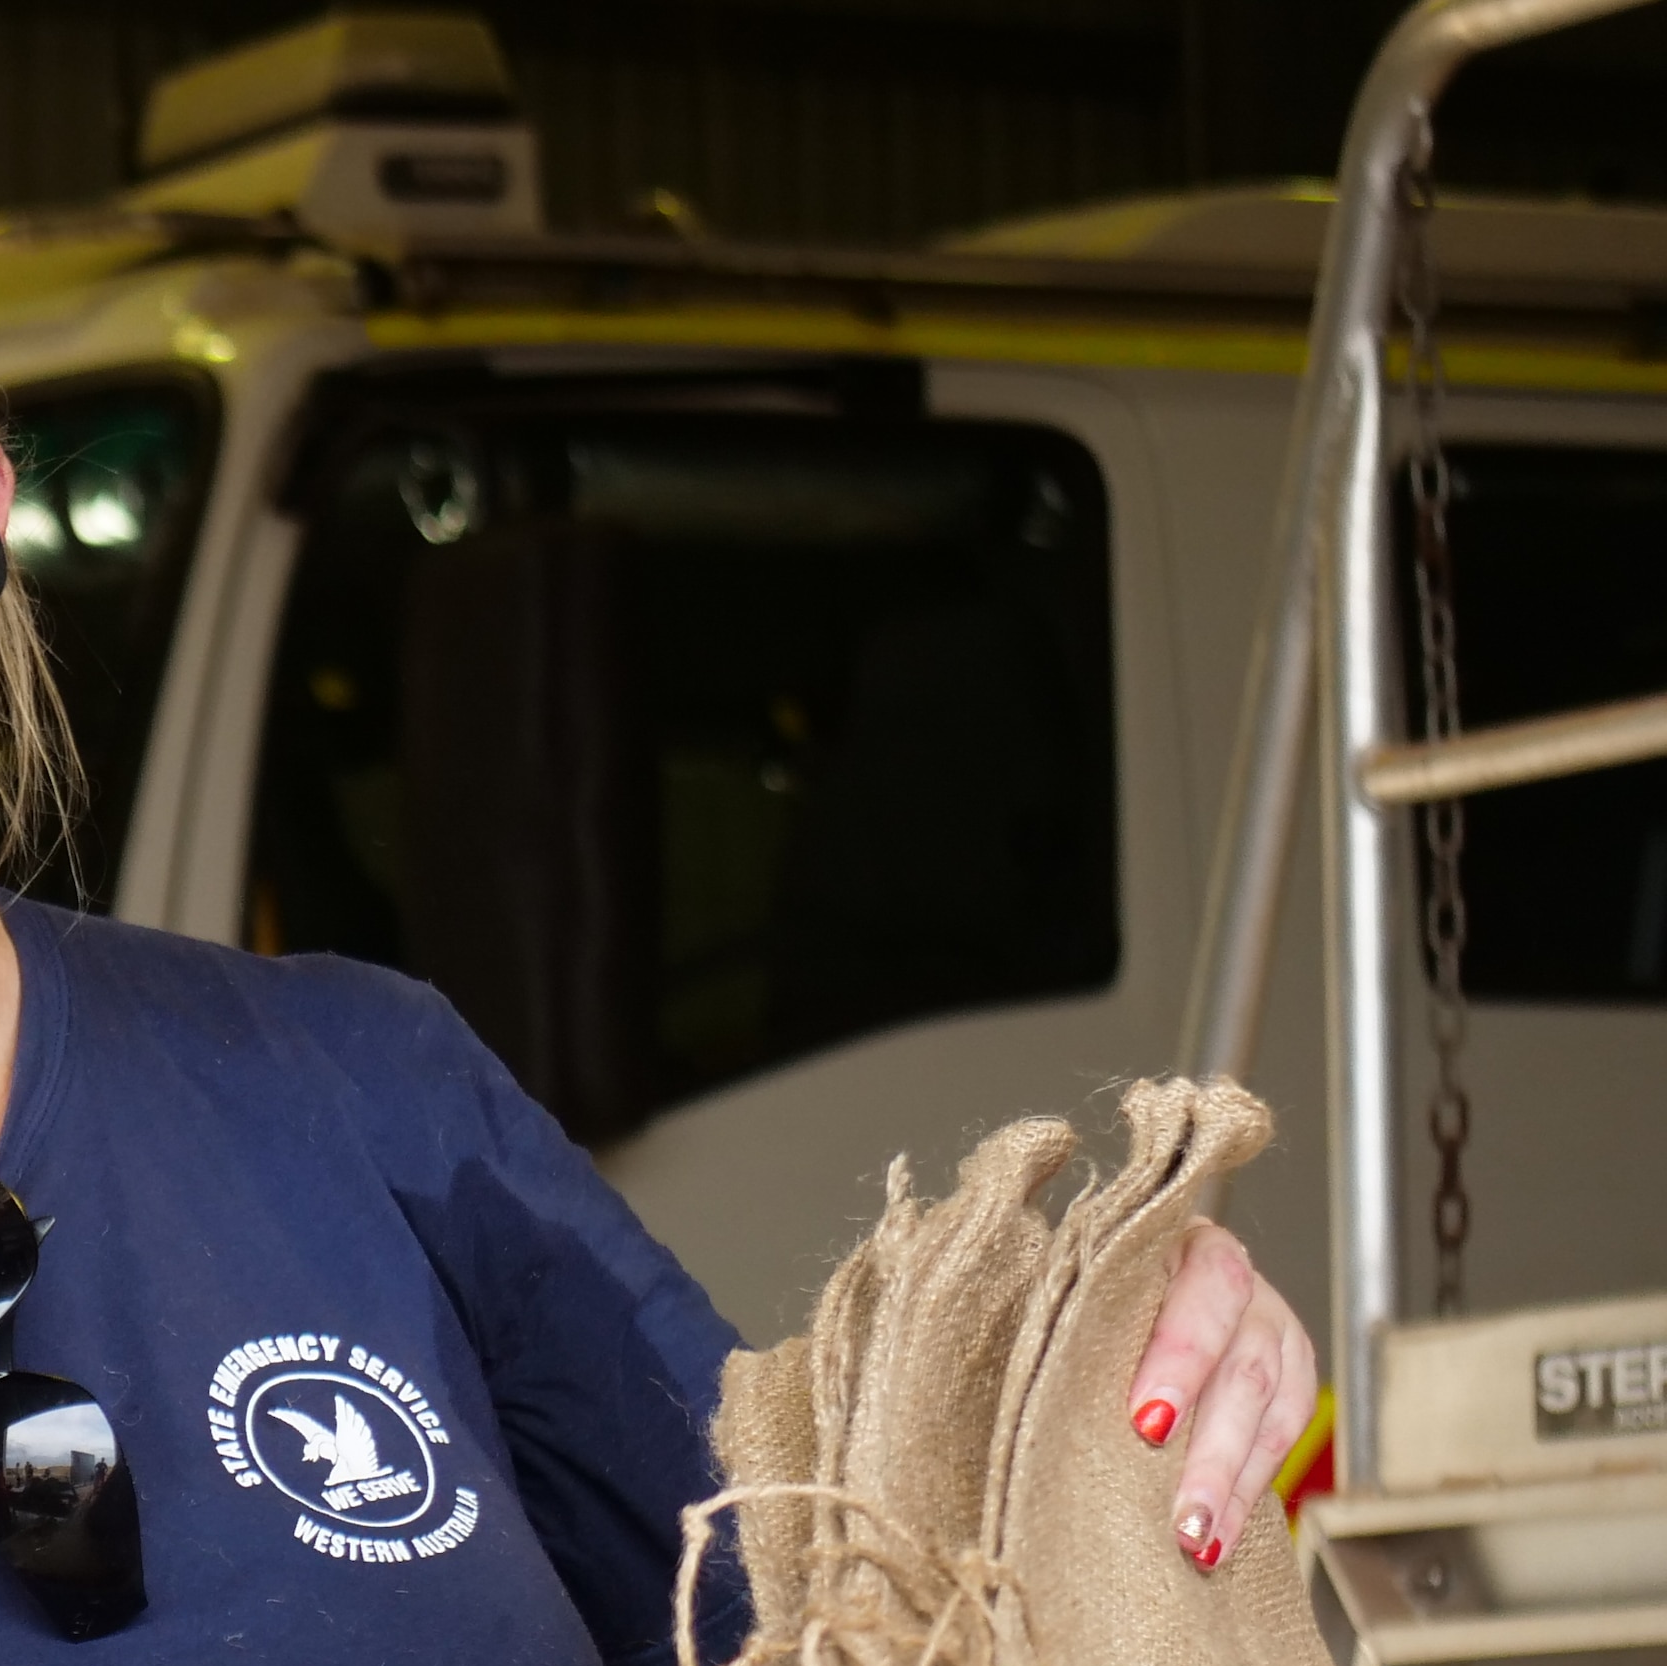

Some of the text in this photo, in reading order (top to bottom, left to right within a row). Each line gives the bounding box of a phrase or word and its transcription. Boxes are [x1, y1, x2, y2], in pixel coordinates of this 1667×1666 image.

[208, 1334, 450, 1488] STATE EMERGENCY SERVICE
[293, 1487, 479, 1563] WESTERN AUSTRALIA
[321, 1470, 421, 1512] WE SERVE
